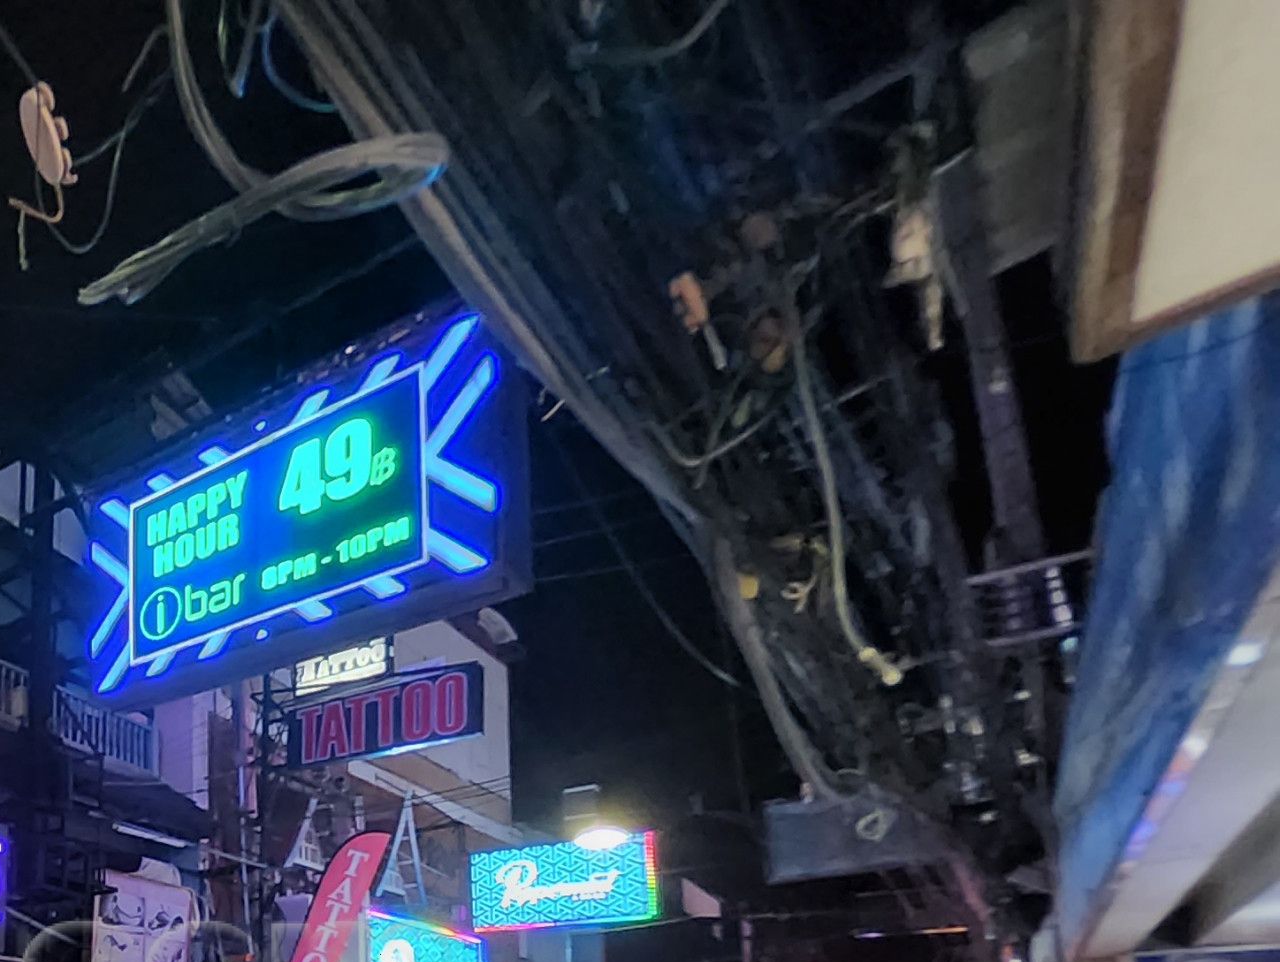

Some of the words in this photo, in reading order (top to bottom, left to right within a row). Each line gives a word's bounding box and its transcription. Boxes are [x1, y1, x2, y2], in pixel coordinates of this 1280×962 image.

[147, 471, 247, 547] HAPPY
[335, 516, 410, 564] 10PM
[153, 513, 239, 578] HOUR
[296, 671, 469, 765] TATTOO
